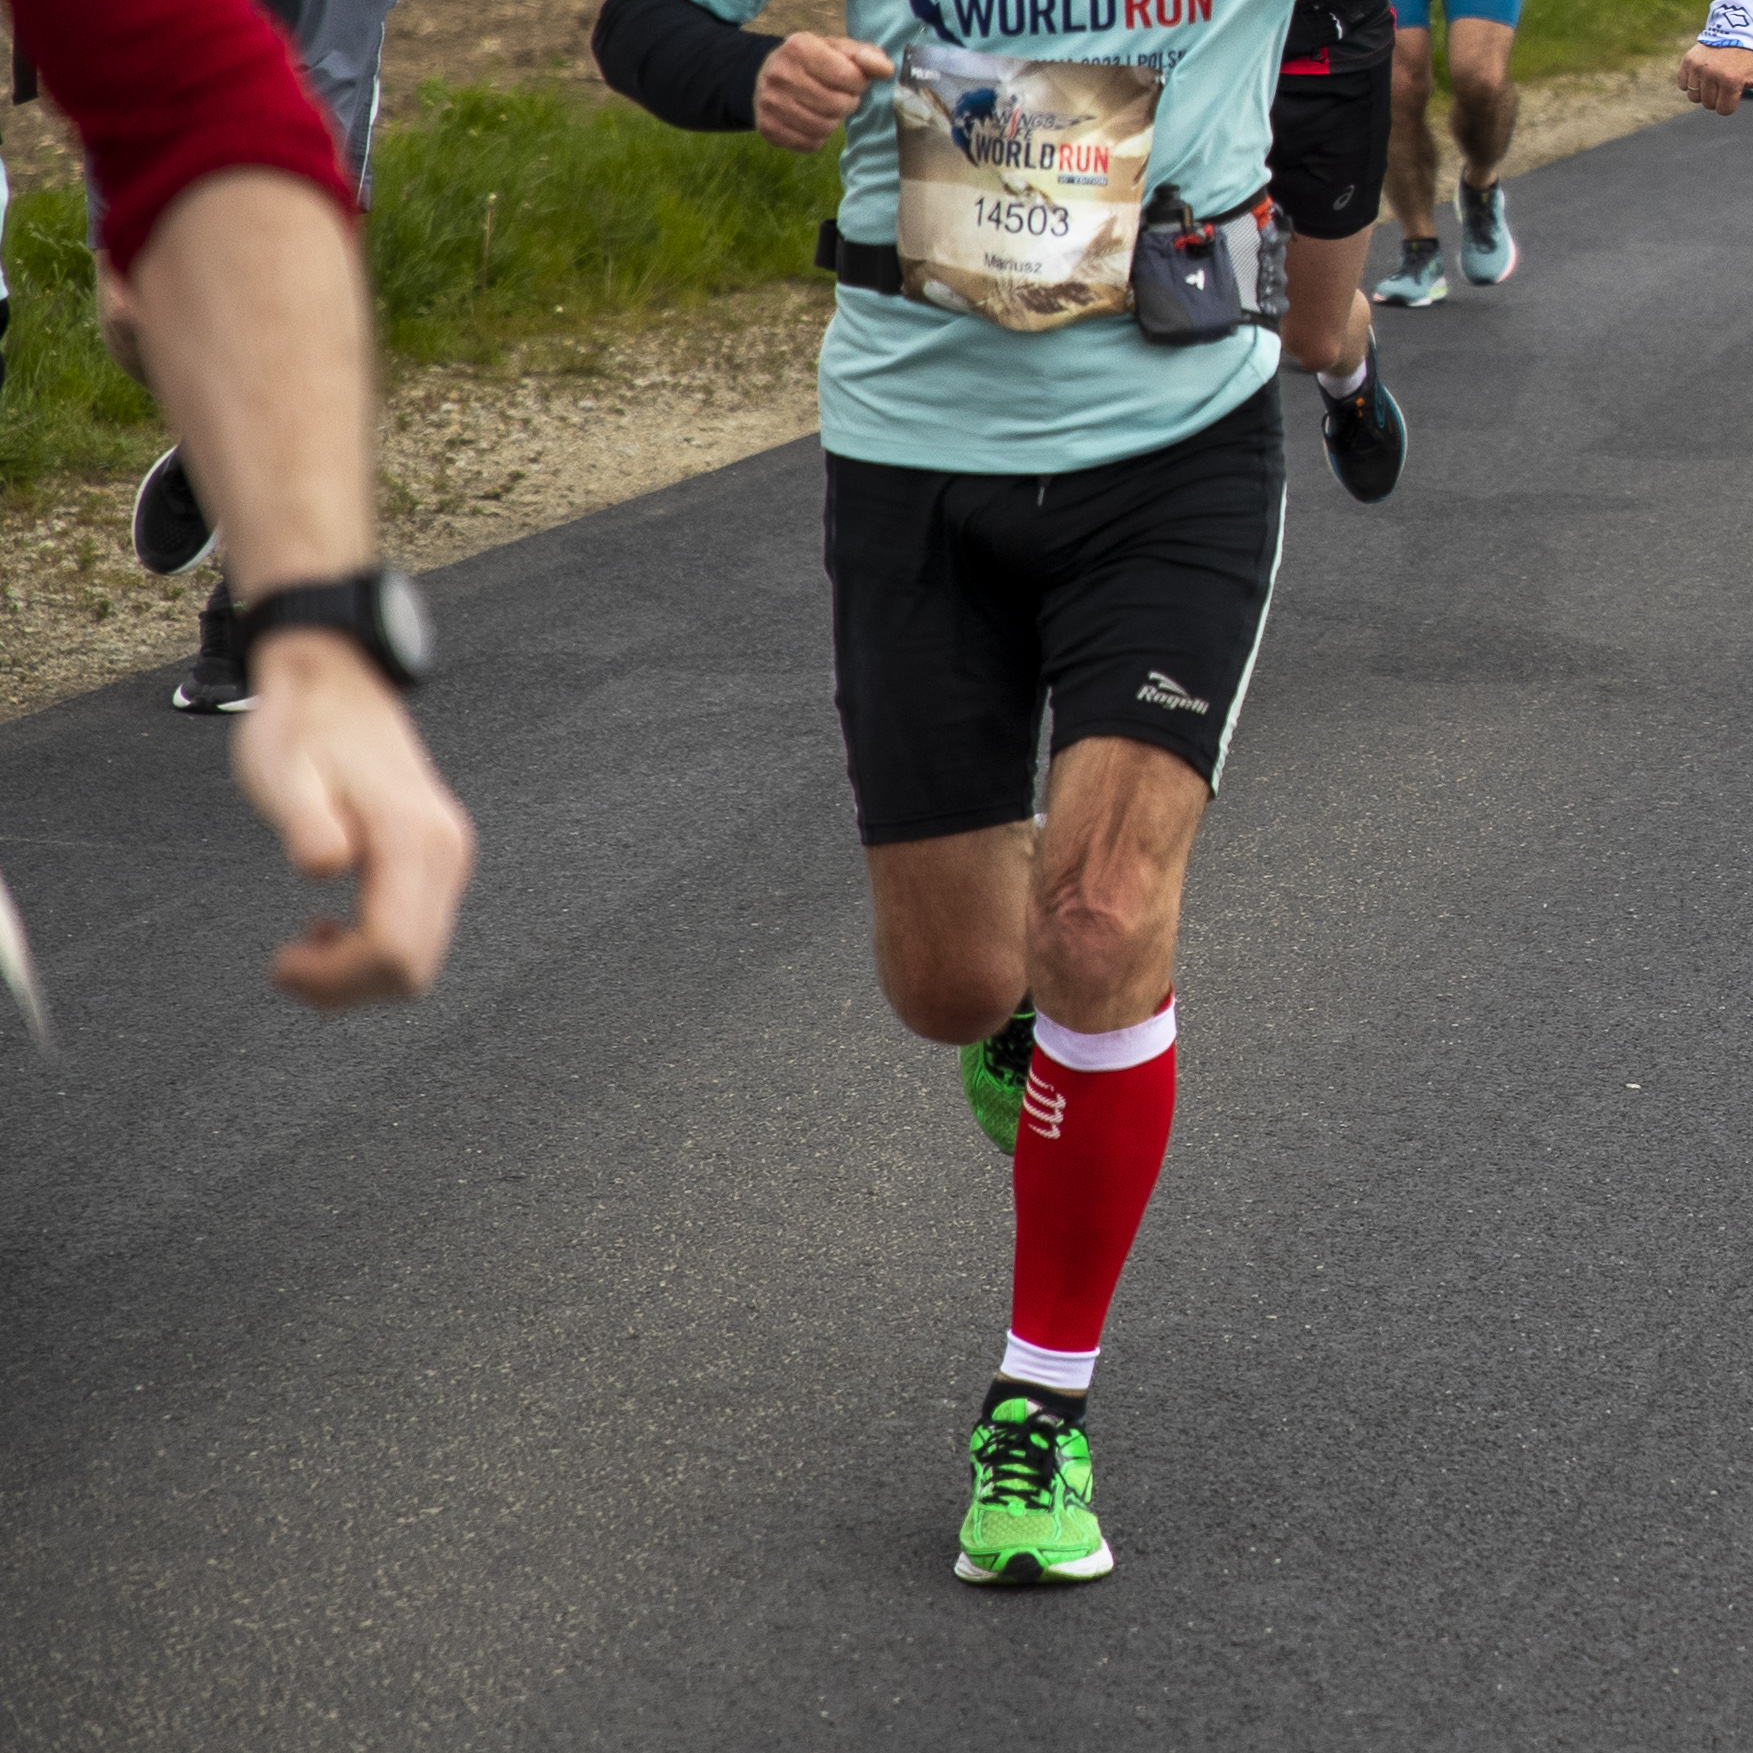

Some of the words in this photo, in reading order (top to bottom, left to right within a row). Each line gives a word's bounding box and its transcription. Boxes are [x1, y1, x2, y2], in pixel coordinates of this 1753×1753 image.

[998, 110, 1056, 128] WINGS
[975, 135, 1056, 170] WORLD
[1058, 142, 1109, 173] RUN
[974, 196, 1069, 237] 14503
[983, 251, 1043, 274] Mariusz
